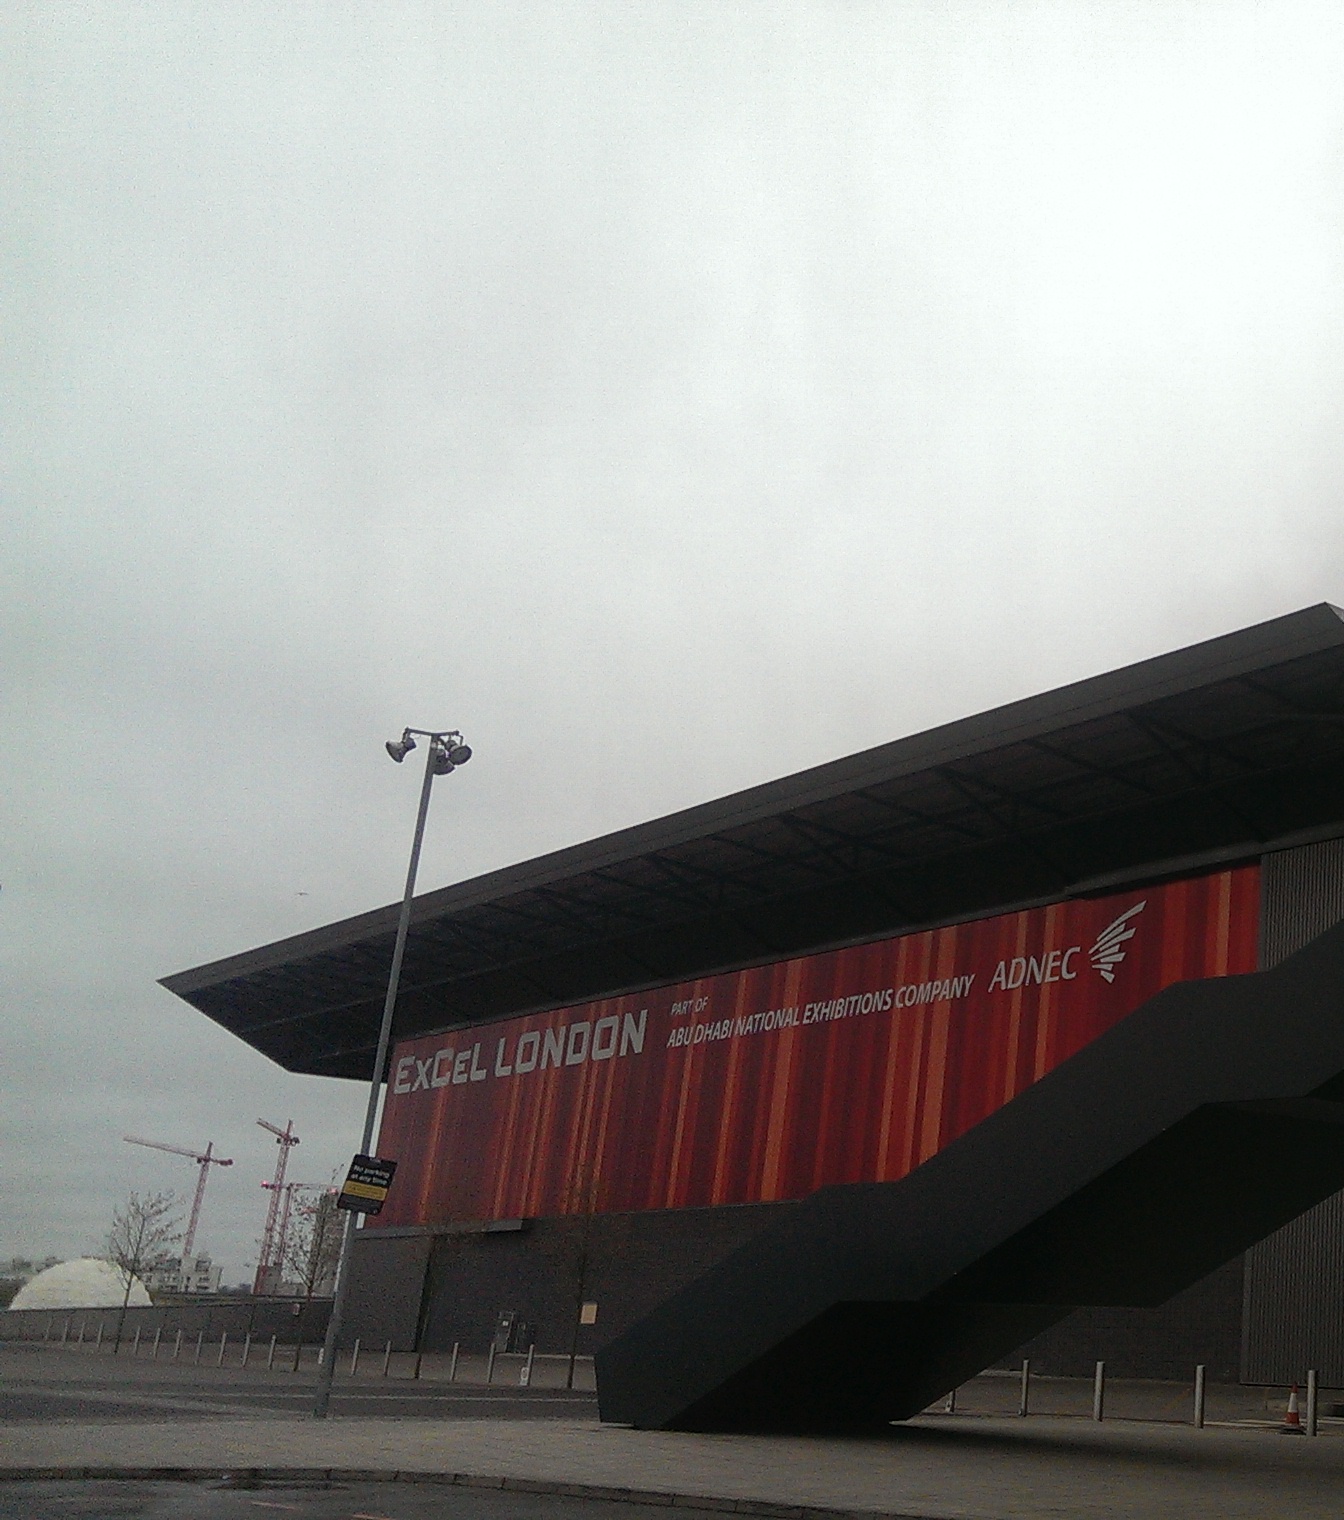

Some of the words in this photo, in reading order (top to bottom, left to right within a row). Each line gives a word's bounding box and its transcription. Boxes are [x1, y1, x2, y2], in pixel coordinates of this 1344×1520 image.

[988, 946, 1081, 993] ADNEC
[666, 1025, 694, 1048] ABU
[693, 1018, 735, 1044] DHABI
[734, 1007, 800, 1036] NATIONAL
[802, 988, 894, 1025] EXHIBITIONS
[895, 973, 976, 1009] COMPANY
[670, 999, 692, 1015] PART
[695, 996, 709, 1013] OF
[494, 1009, 648, 1078] LONDON
